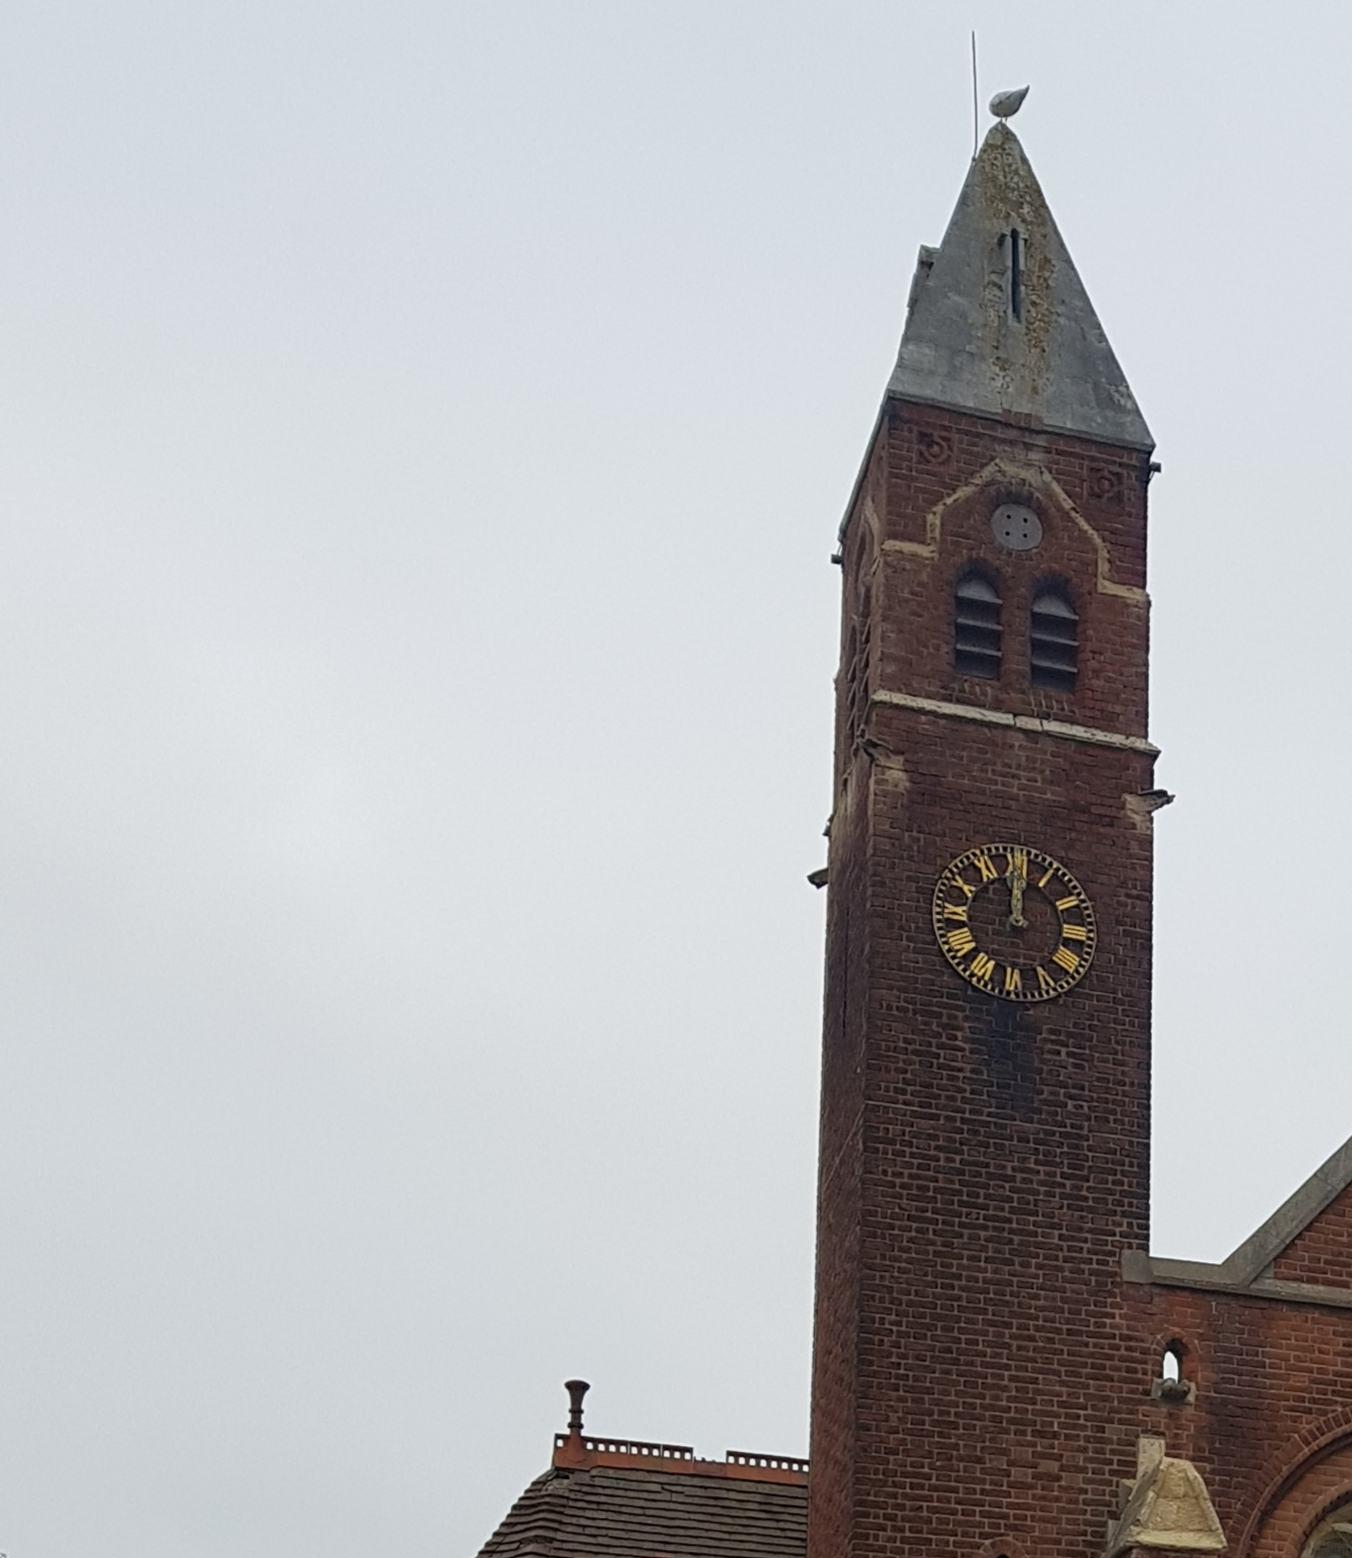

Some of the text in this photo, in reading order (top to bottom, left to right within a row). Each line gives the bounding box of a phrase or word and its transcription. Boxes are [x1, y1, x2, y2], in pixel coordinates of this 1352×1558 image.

[974, 854, 999, 883] XI
[950, 874, 977, 897] X
[1055, 895, 1080, 911] II
[946, 926, 977, 958] VIII
[1062, 923, 1088, 942] III
[969, 951, 997, 982] VII
